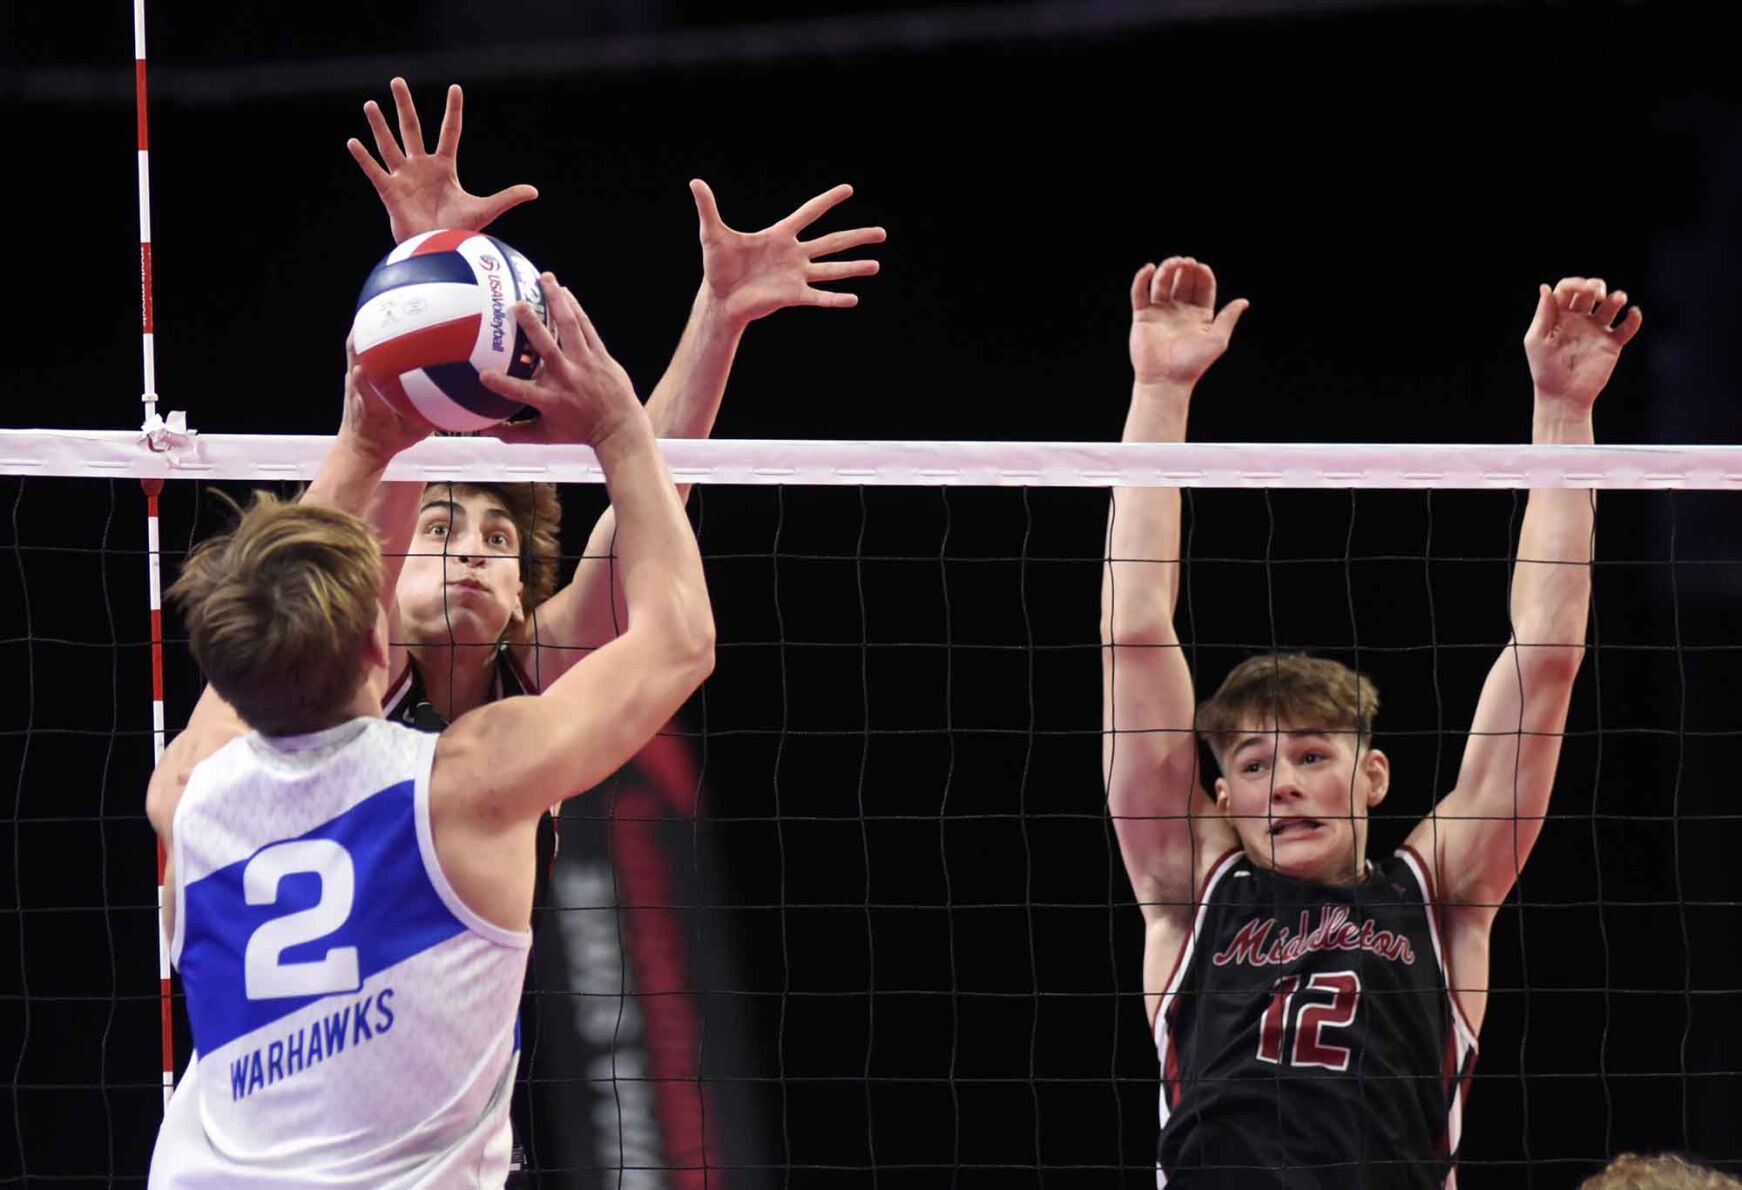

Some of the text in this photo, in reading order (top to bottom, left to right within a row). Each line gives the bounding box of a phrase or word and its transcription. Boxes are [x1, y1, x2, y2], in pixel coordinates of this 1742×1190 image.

[243, 838, 360, 1001] 2
[1213, 903, 1415, 966] Middleton
[231, 988, 395, 1102] WARHAWKS
[1256, 970, 1361, 1071] 12
